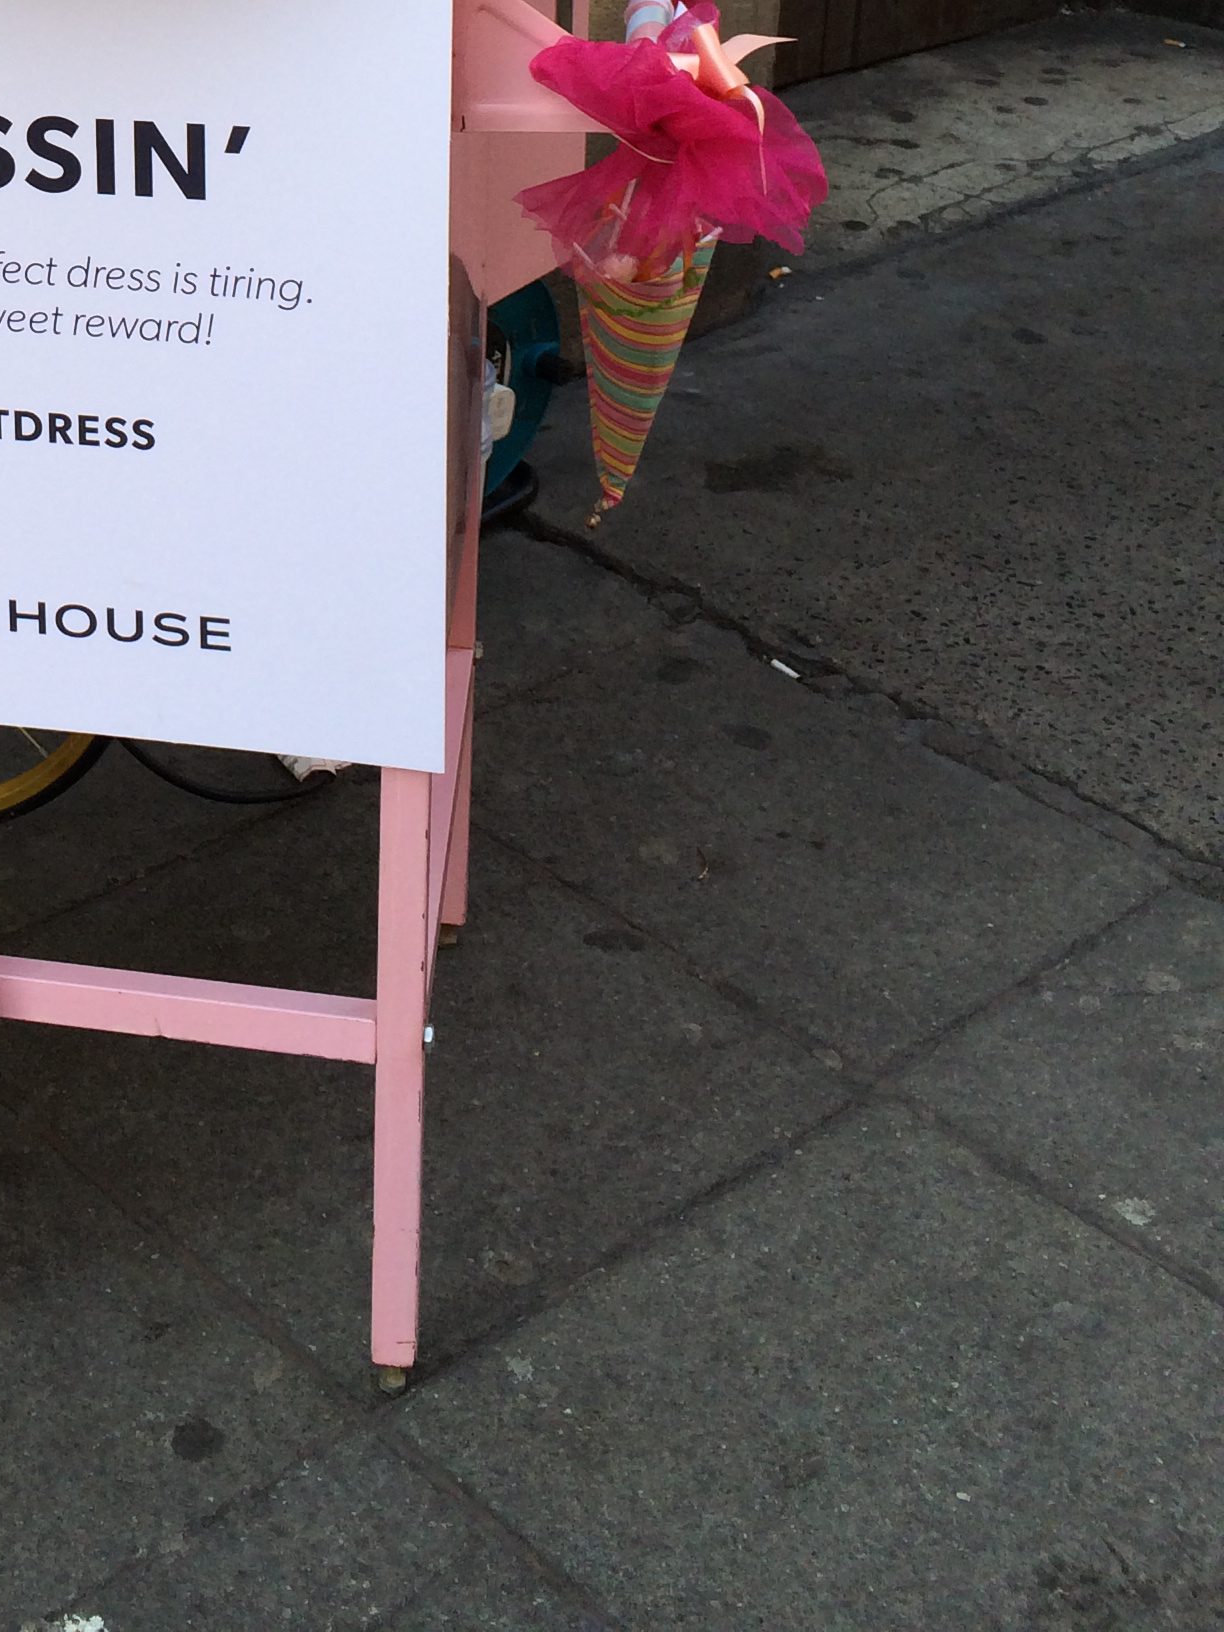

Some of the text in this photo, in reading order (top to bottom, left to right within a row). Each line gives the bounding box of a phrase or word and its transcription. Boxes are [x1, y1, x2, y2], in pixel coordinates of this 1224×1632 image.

[67, 255, 161, 293] dress
[173, 263, 198, 295] is
[209, 266, 313, 311] tiring.
[72, 312, 215, 346] reward!
